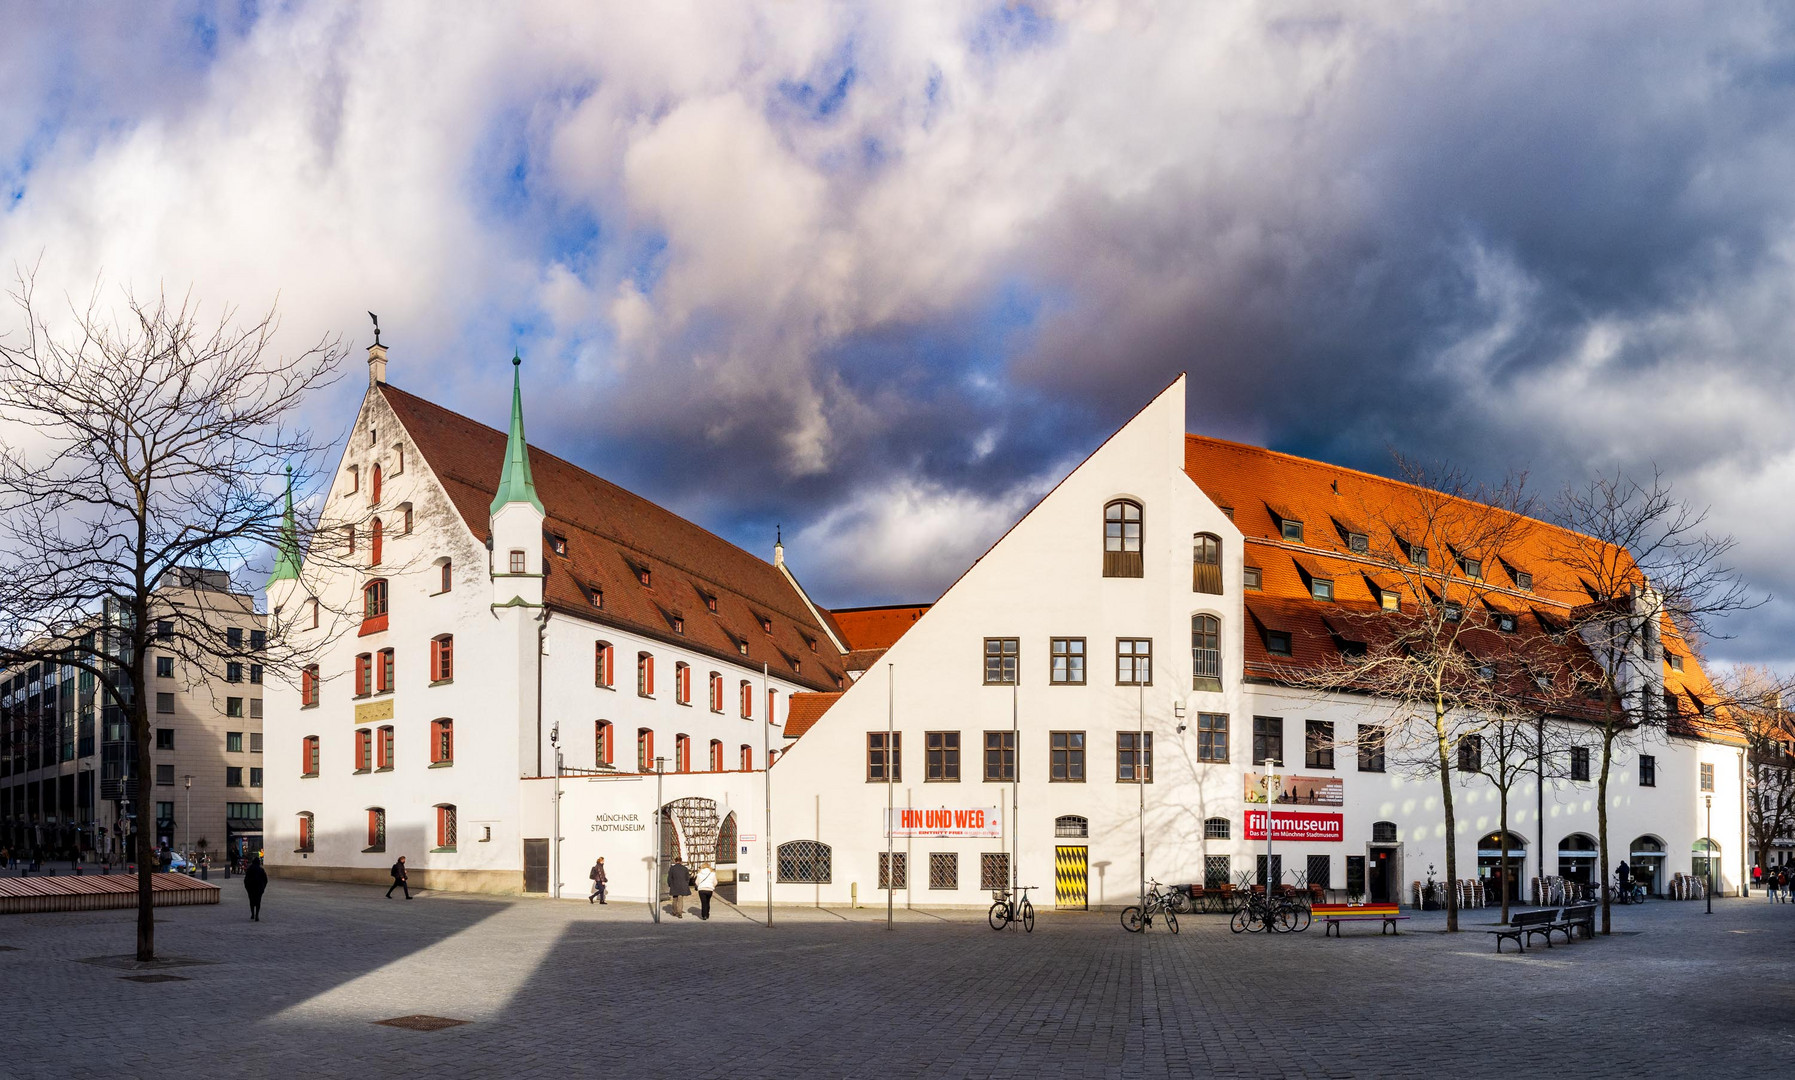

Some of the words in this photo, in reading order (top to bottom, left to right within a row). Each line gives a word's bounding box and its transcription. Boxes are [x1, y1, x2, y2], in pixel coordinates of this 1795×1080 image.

[596, 813, 639, 821] MÜNCHNER
[901, 810, 922, 828] HIN
[925, 810, 952, 828] UND
[954, 810, 984, 828] WEG
[1250, 814, 1339, 831] filmmuseum
